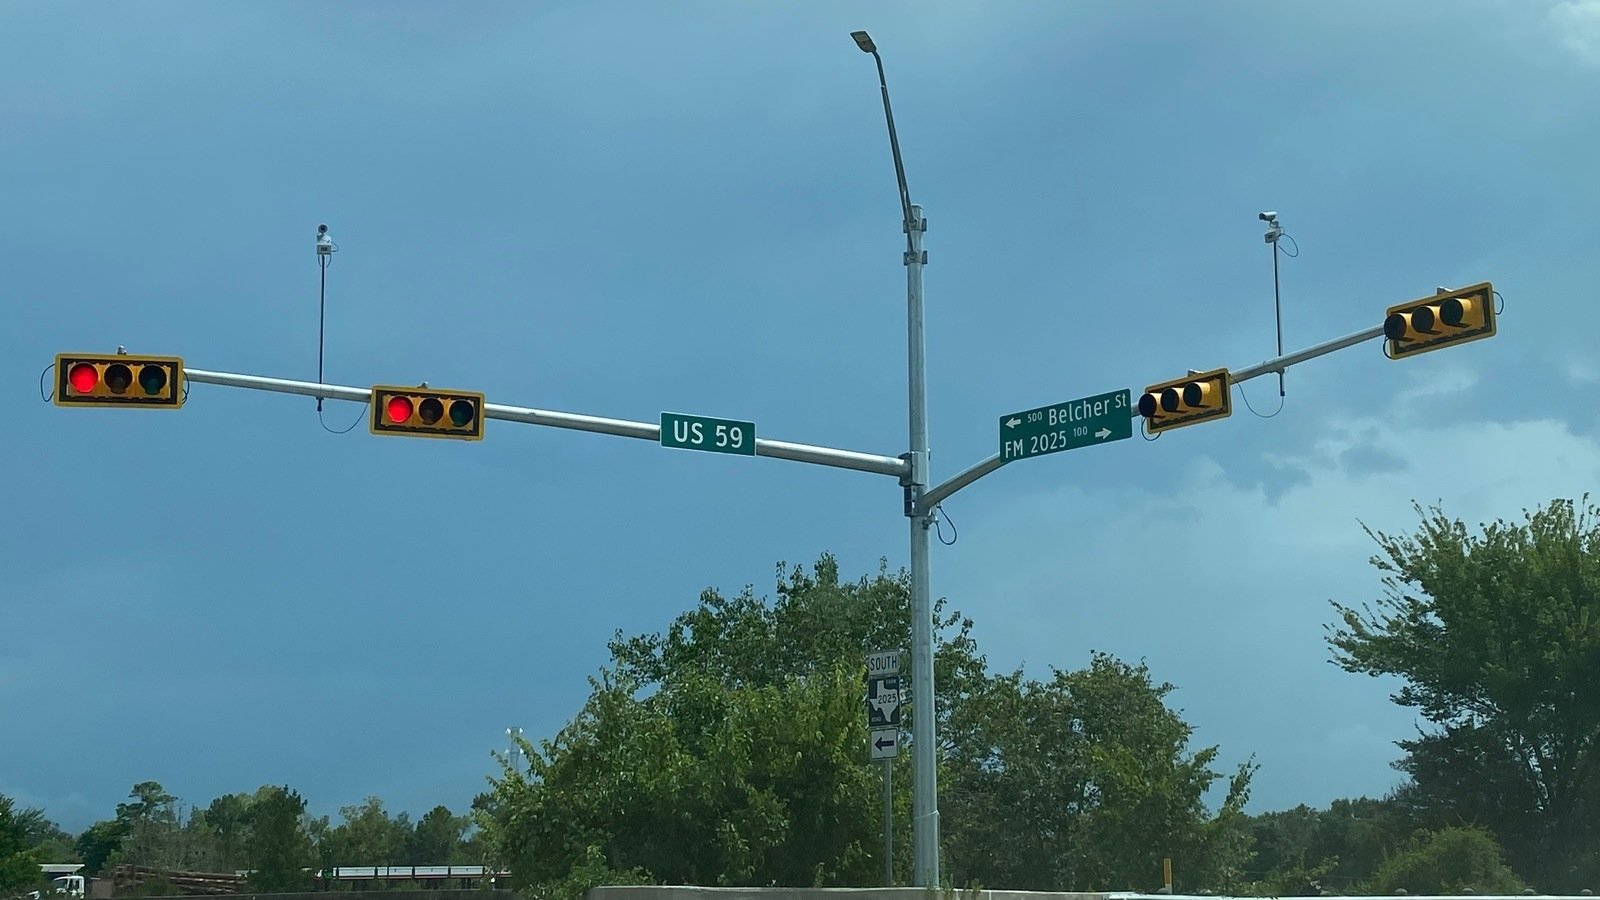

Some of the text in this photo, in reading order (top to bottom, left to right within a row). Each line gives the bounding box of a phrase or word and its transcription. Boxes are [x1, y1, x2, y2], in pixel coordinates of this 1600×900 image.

[1027, 393, 1127, 426] 500 Belcher St
[674, 420, 743, 448] US 59
[1005, 426, 1088, 459] FM 2025 100
[870, 656, 897, 671] SOUTH
[878, 694, 897, 705] 2025
